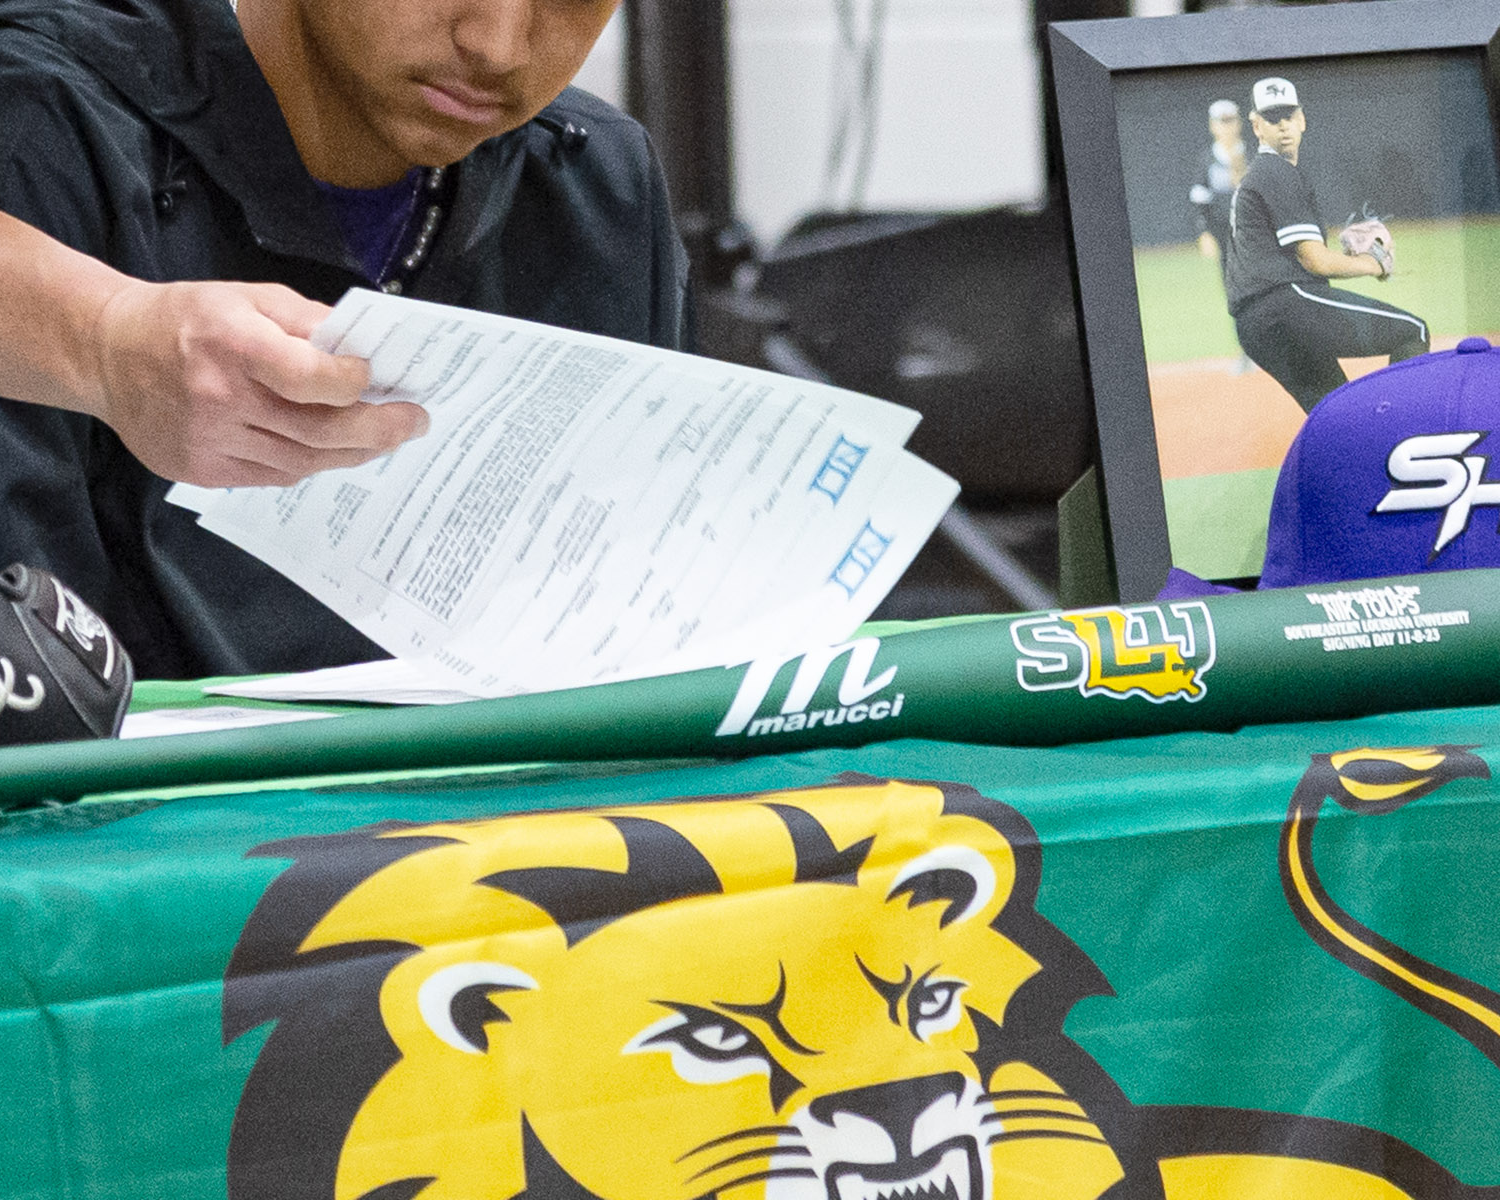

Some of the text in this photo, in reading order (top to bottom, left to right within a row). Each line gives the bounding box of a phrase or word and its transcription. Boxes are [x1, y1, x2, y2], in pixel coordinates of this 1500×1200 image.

[1323, 595, 1420, 622] NIK TOUPS
[1362, 615, 1414, 632] LOUISIANA
[1414, 610, 1470, 627] UNIVERSITY
[1322, 634, 1372, 651] SIGNING
[1373, 631, 1395, 647] DAY
[747, 693, 905, 737] marucci
